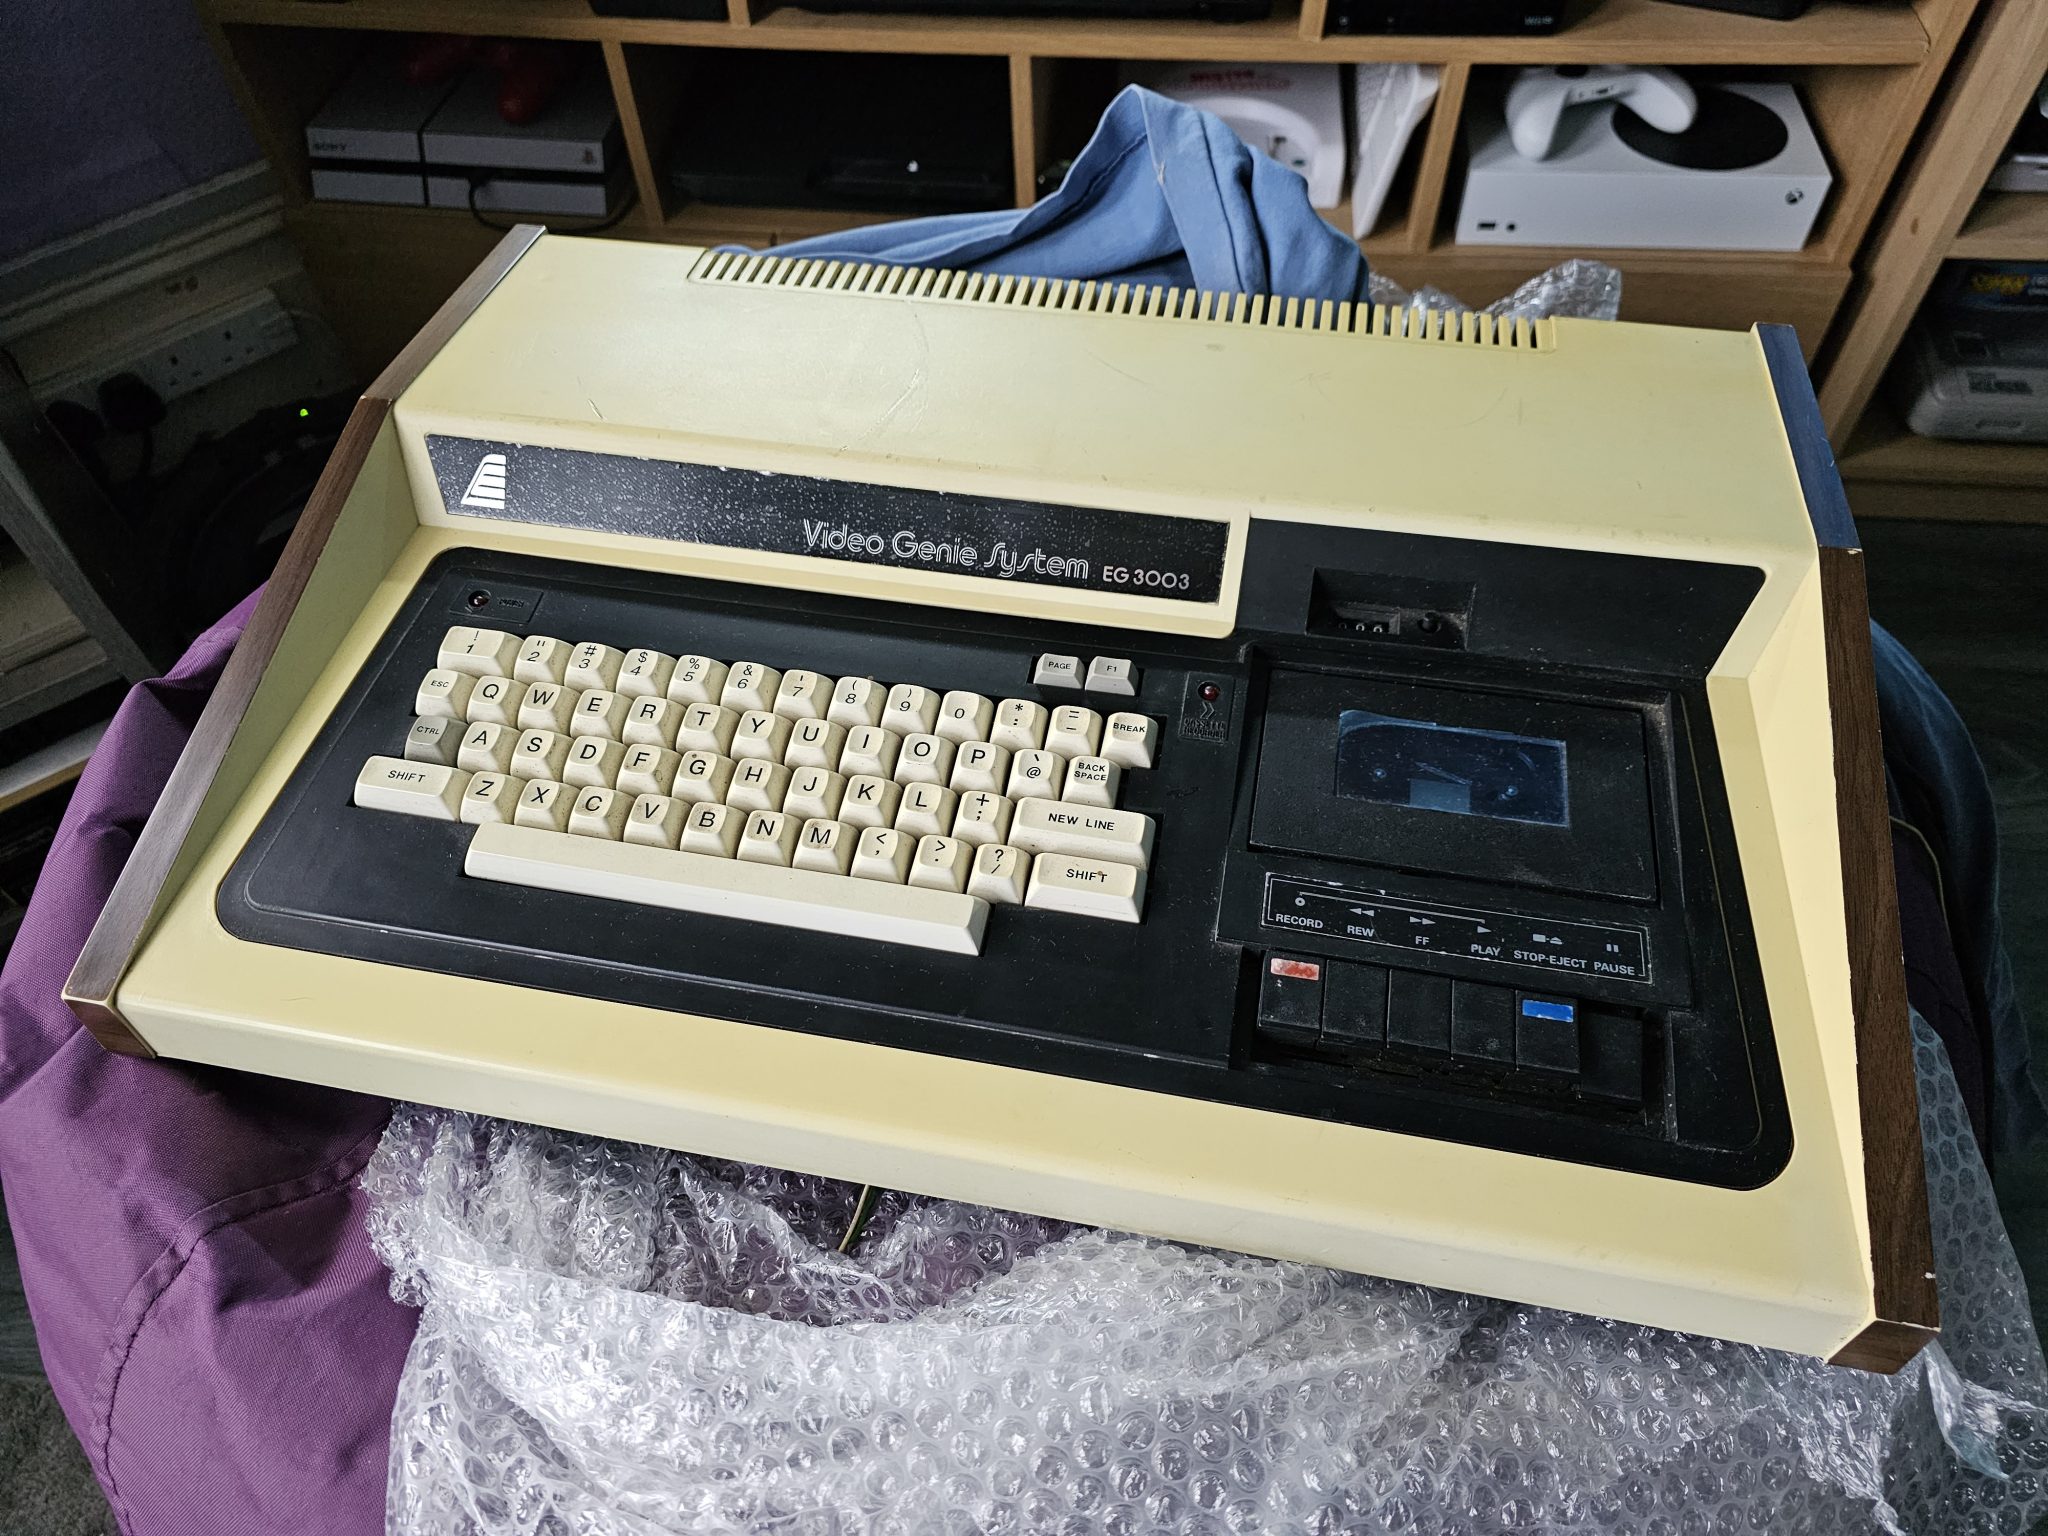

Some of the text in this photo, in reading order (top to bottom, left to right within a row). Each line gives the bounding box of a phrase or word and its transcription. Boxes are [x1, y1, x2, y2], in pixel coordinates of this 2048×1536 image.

[803, 517, 1190, 590] Video Genie System EG 3003
[527, 651, 540, 662] 2
[578, 658, 591, 669] 3
[630, 665, 642, 676] 4
[1048, 661, 1072, 671] PAGE
[1105, 664, 1117, 672] F1
[430, 679, 449, 688] ESC
[682, 671, 695, 682] 5
[736, 678, 749, 689] 6
[481, 683, 500, 700] Q
[531, 689, 555, 705] W
[792, 686, 804, 696] 7
[844, 693, 857, 704] 8
[586, 697, 603, 712] E
[639, 703, 657, 719] R
[899, 700, 911, 712] 9
[696, 710, 711, 726] T
[953, 707, 965, 719] 0
[416, 725, 440, 736] CTRL
[751, 717, 766, 734] Y
[801, 725, 820, 742] U
[1113, 722, 1146, 734] BREAK
[470, 730, 488, 745] A
[525, 736, 543, 752] S
[862, 733, 870, 749] I
[578, 743, 597, 760] D
[913, 741, 931, 757] O
[970, 748, 986, 764] P
[633, 752, 650, 767] F
[689, 759, 707, 775] G
[1078, 762, 1106, 773] BACK
[386, 769, 426, 783] SHIFT
[744, 766, 763, 783] H
[1074, 770, 1108, 782] SPACE
[474, 780, 495, 796] Z
[802, 776, 818, 792] J
[857, 783, 875, 801] K
[530, 786, 551, 803] X
[915, 790, 928, 808] L
[584, 795, 603, 812] C
[644, 802, 660, 819] V
[698, 811, 715, 827] B
[756, 818, 776, 836] N
[1048, 812, 1115, 831] NEW LINE
[809, 827, 832, 845] M
[1066, 868, 1108, 883] SHIFT
[1276, 913, 1635, 976] RECORD REW FF PLAY STOP-EJECT PAUSE
